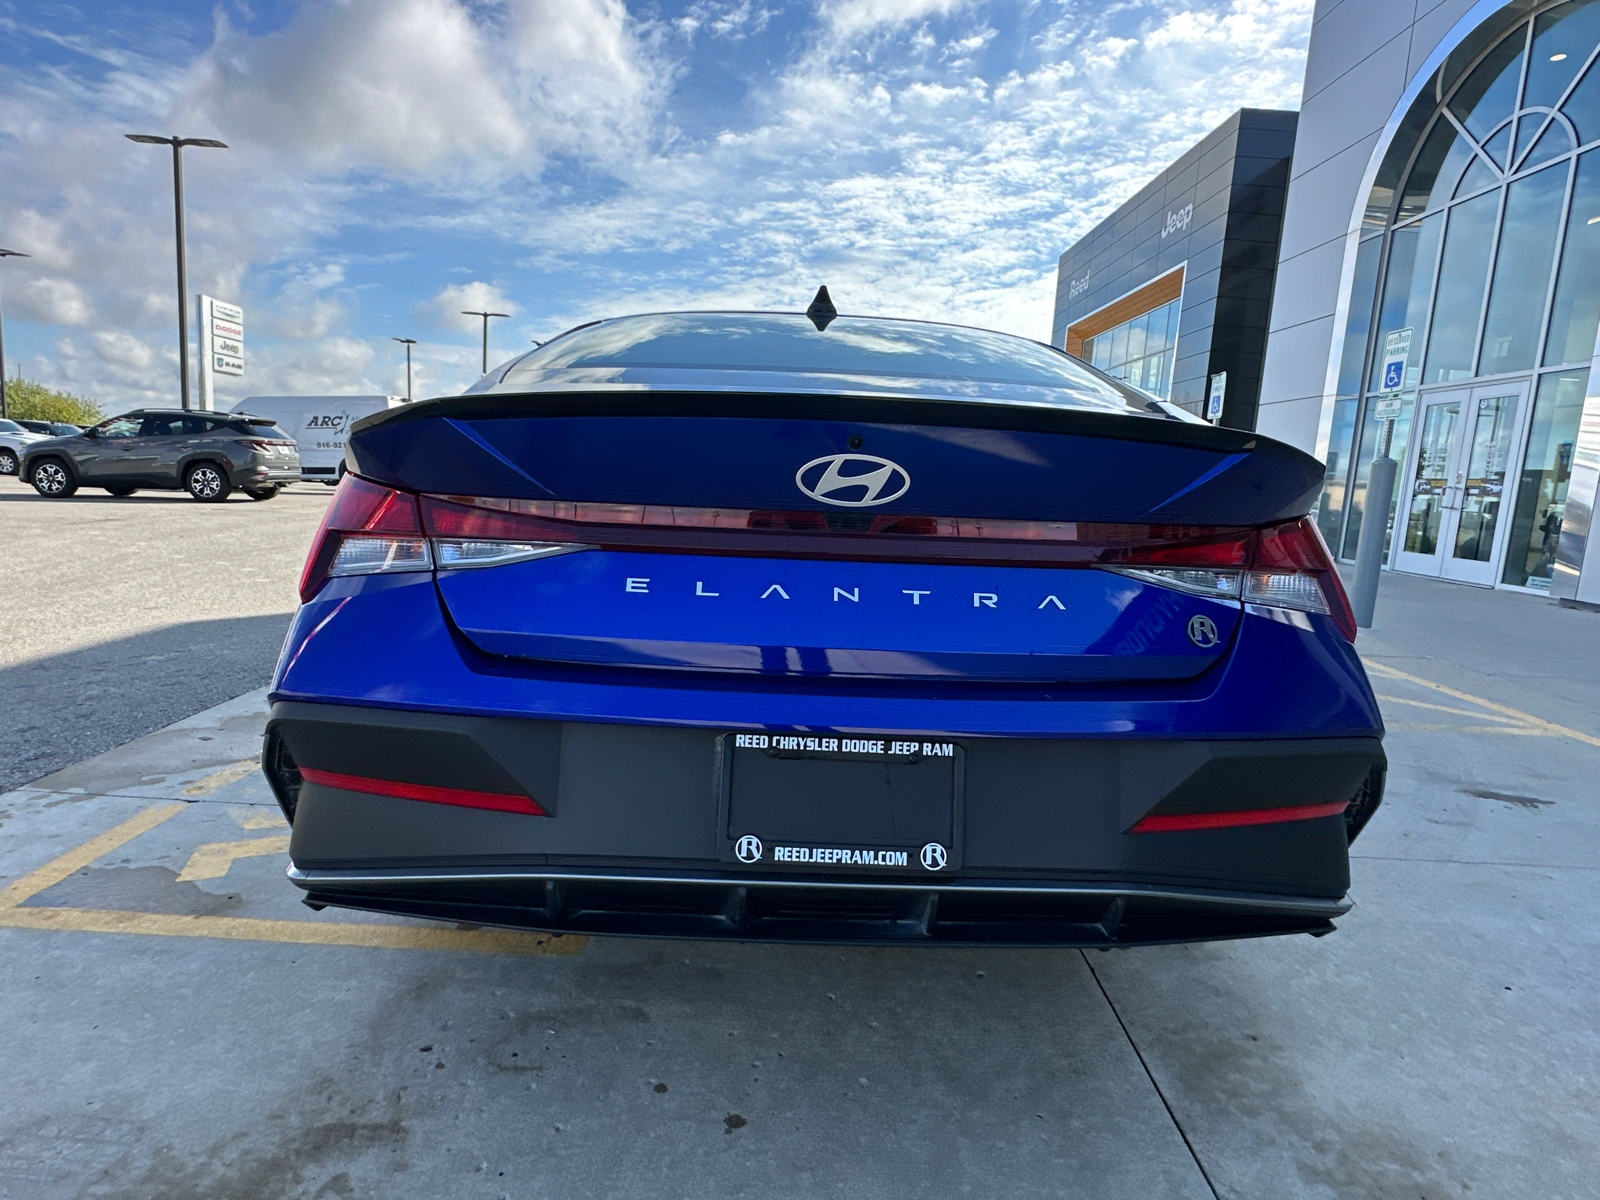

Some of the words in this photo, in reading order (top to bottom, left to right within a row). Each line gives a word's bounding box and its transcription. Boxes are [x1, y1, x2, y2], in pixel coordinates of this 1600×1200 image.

[1161, 203, 1193, 238] Jeep
[1069, 269, 1090, 300] Reed
[215, 324, 241, 335] DODGE
[220, 341, 239, 354] Jeep
[1386, 346, 1409, 357] PARKING
[225, 361, 242, 369] RAM
[307, 416, 343, 426] ARC
[625, 577, 1066, 610] ELANTRA
[736, 734, 768, 749] REED
[772, 736, 838, 752] CHRYSLER
[842, 739, 884, 754] DODGE
[888, 741, 919, 755] JEEP
[922, 743, 953, 757] RAM
[774, 846, 907, 866] REEDJEEPRAM.COM
